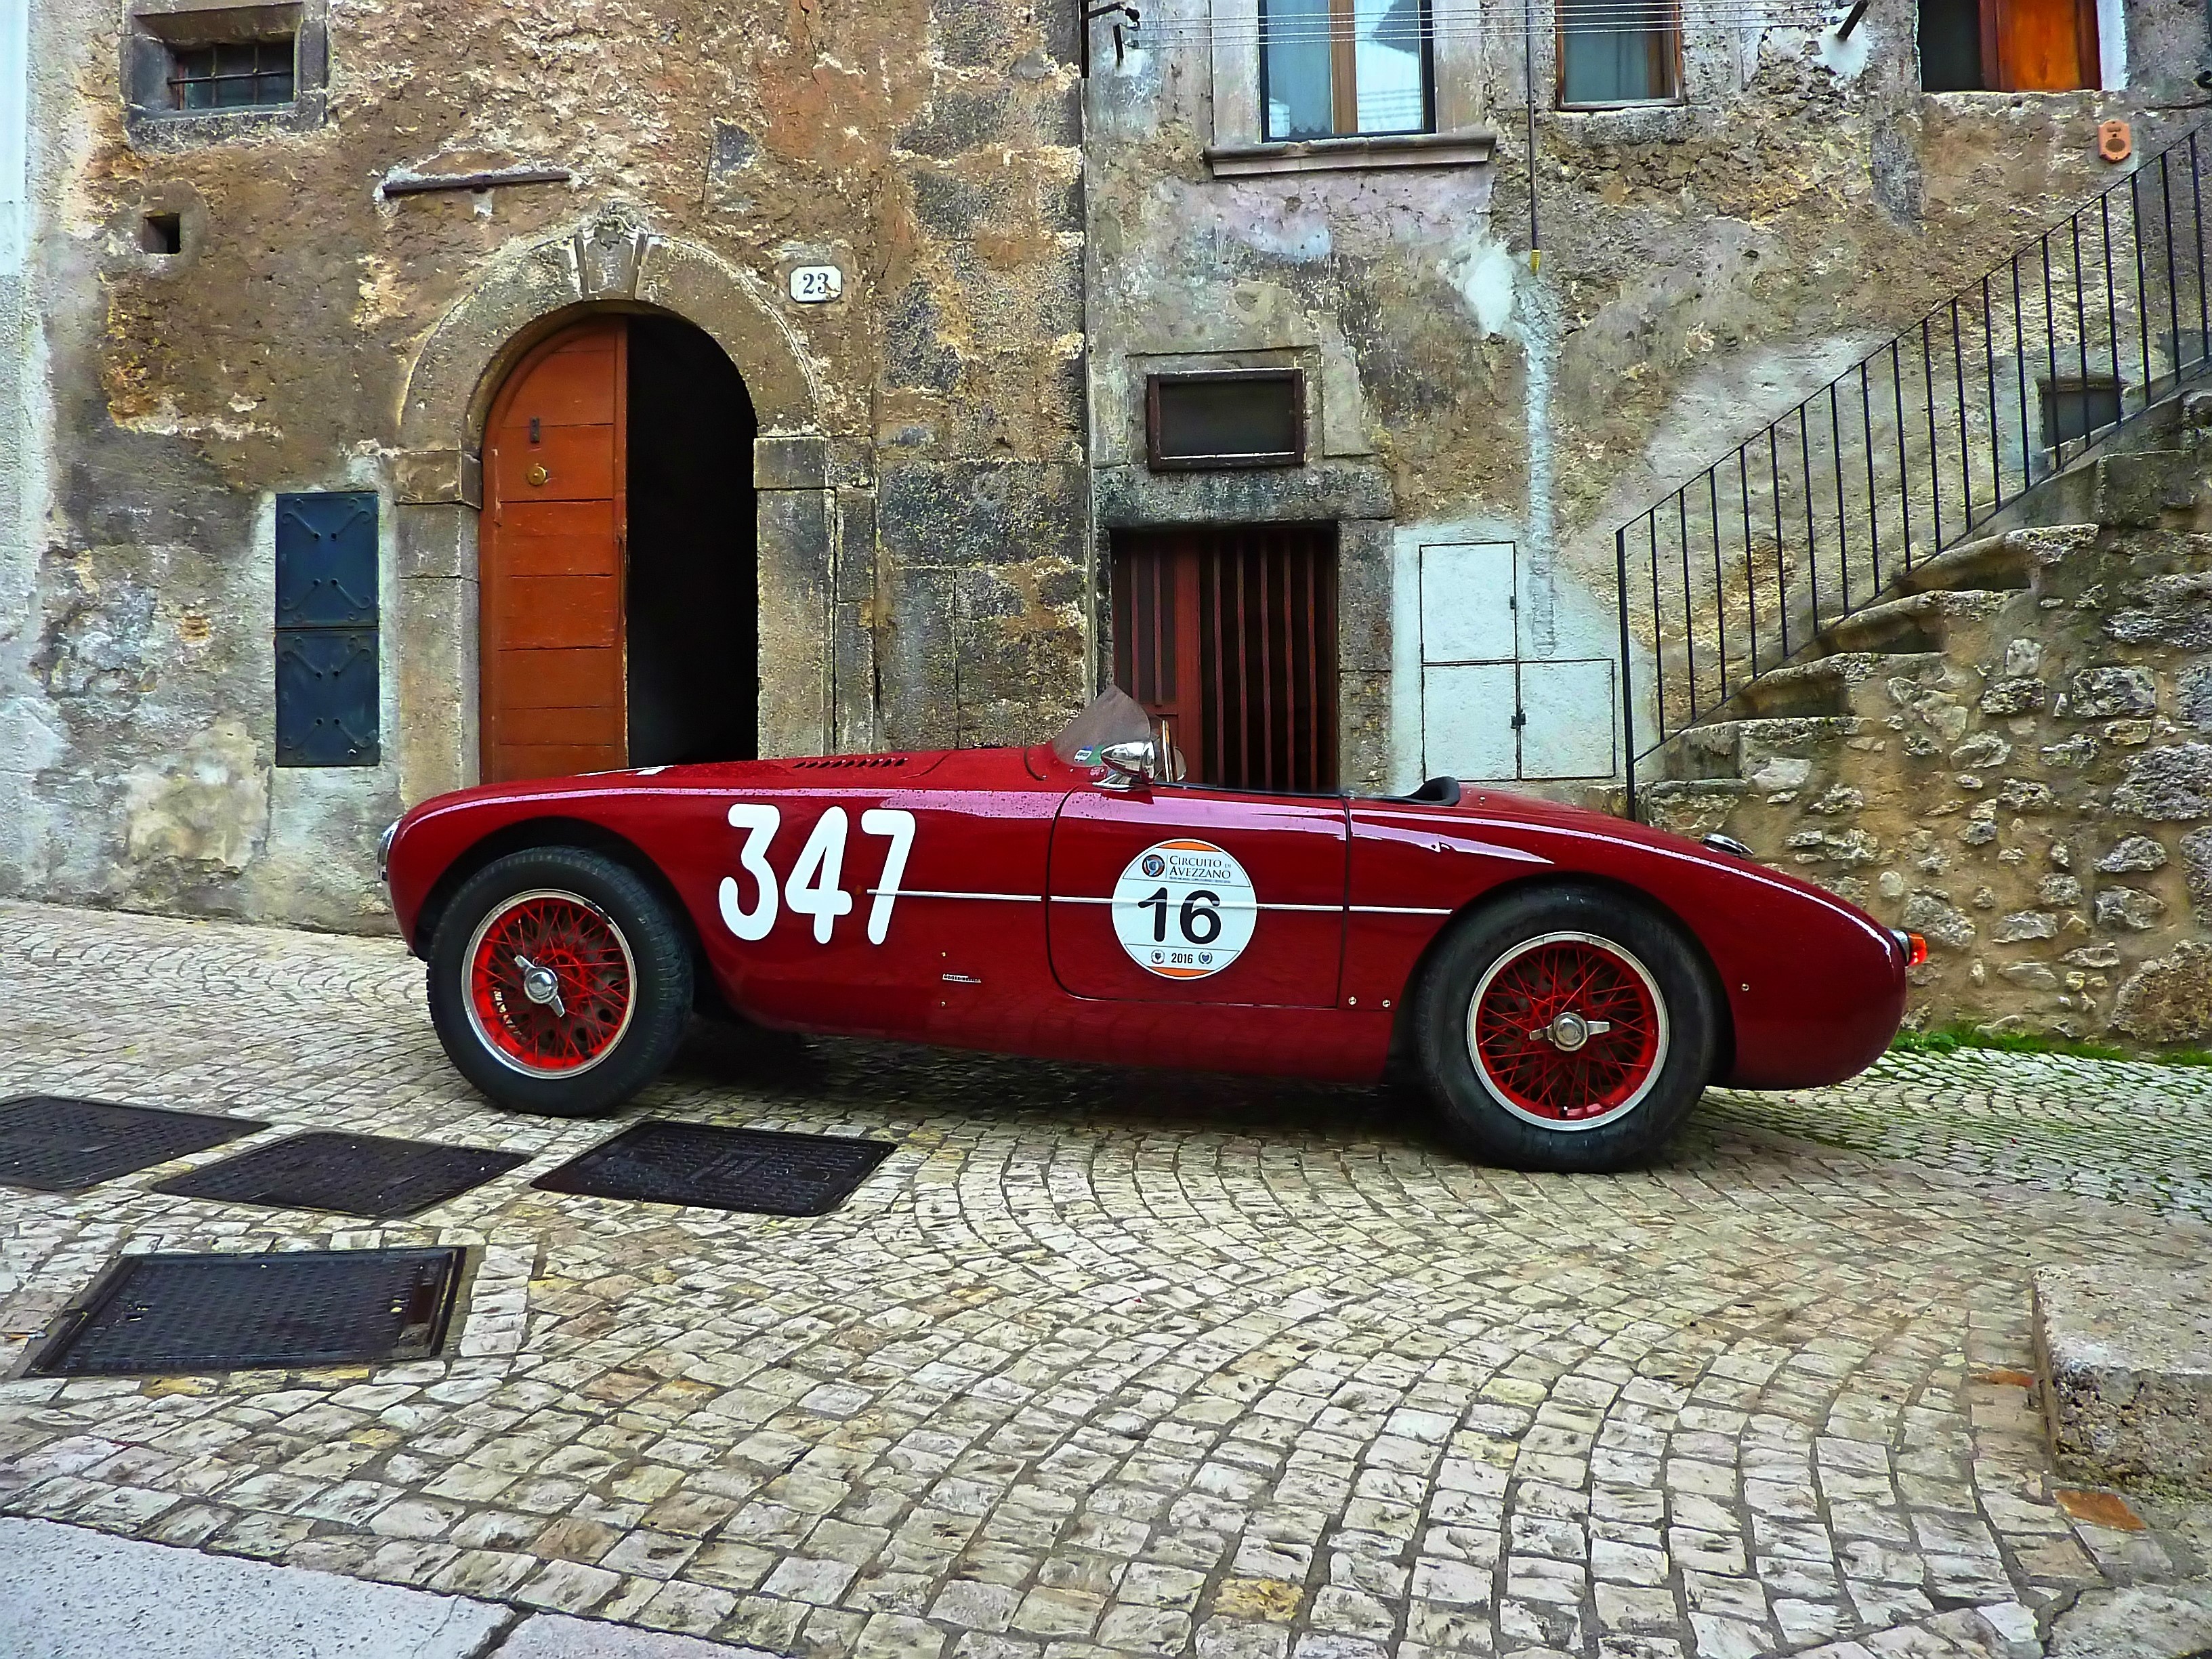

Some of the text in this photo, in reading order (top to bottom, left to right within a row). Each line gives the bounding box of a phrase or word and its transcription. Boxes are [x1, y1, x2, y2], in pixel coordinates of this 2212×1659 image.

[803, 272, 829, 294] 23
[1169, 856, 1222, 867] CIRCUITO
[719, 803, 916, 945] 347
[1169, 866, 1231, 879] AVEZZANO
[1138, 887, 1222, 944] 16
[1171, 952, 1193, 964] 2016
